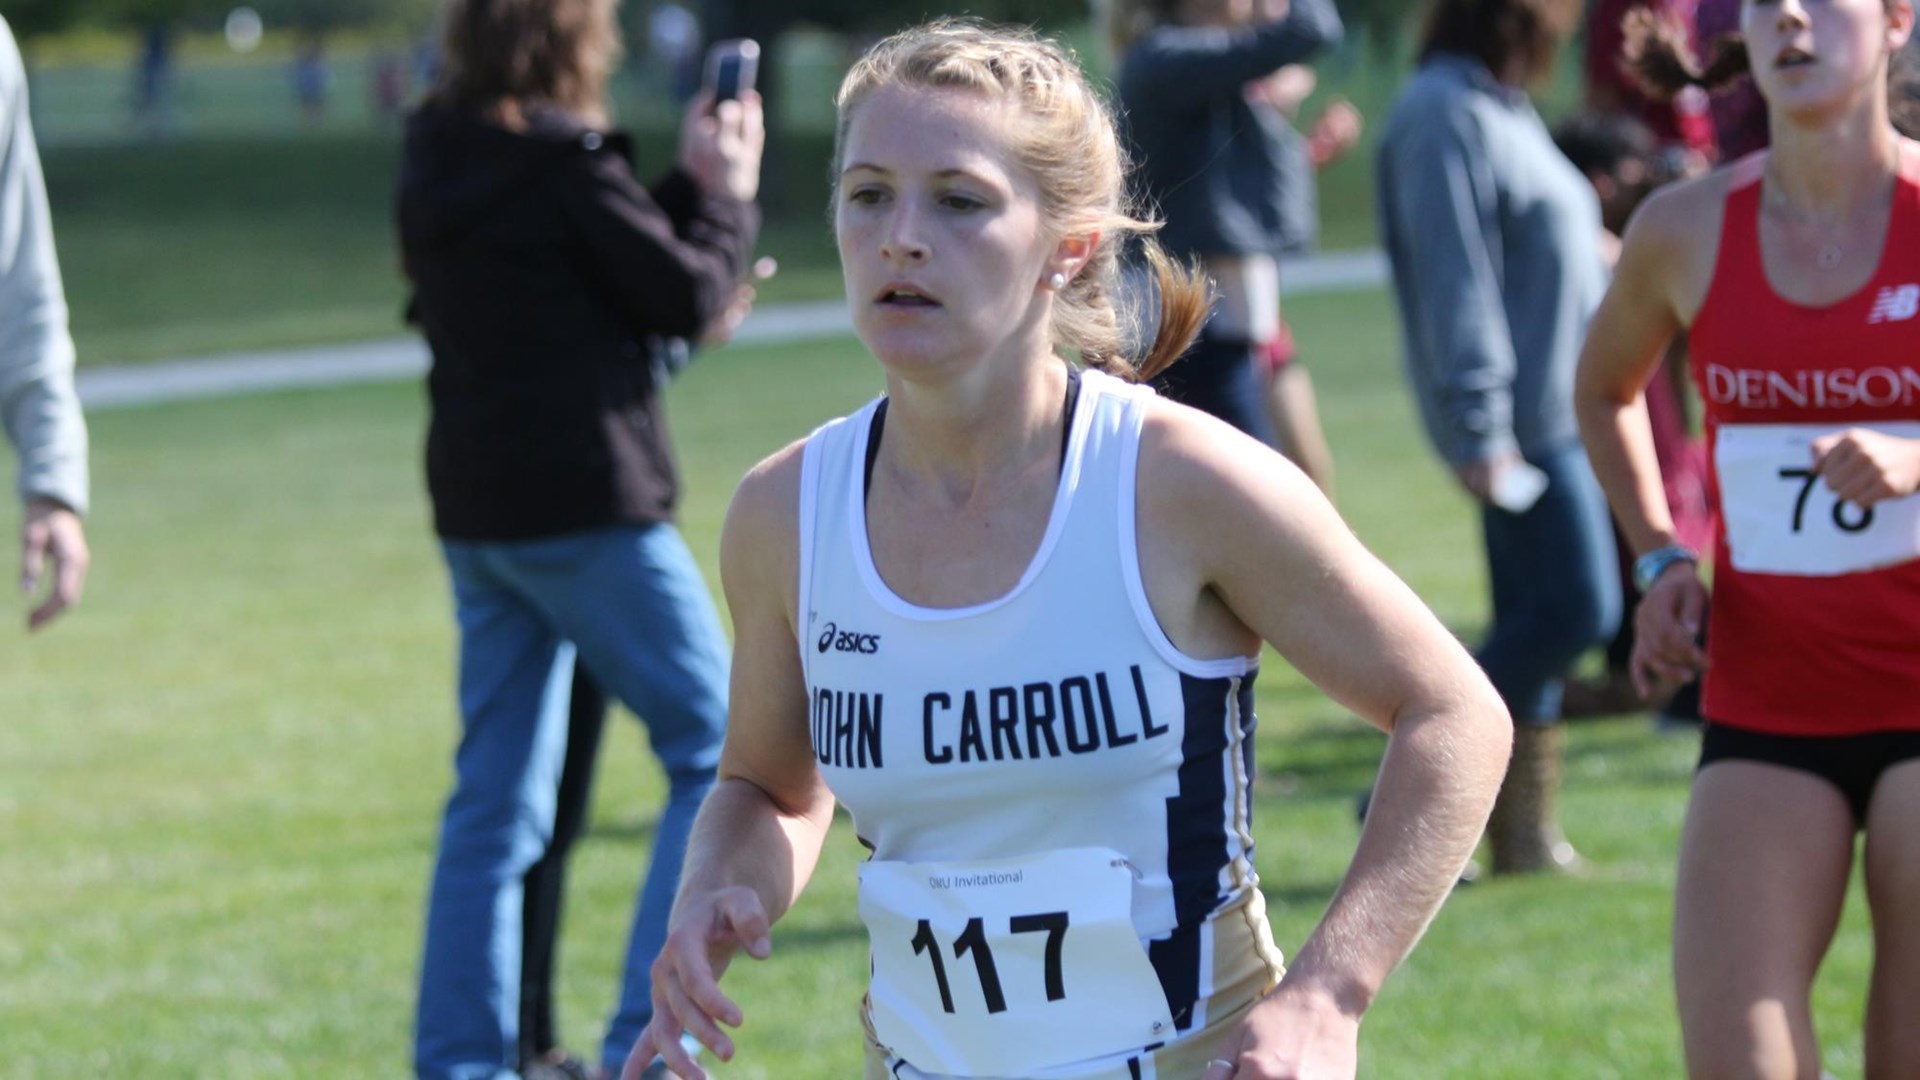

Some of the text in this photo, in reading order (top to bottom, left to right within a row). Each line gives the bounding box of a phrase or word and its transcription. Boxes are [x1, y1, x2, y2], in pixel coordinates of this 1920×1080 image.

[922, 664, 1170, 764] CARROLL
[954, 869, 1023, 888] Invitational
[911, 911, 1069, 1014] 117
